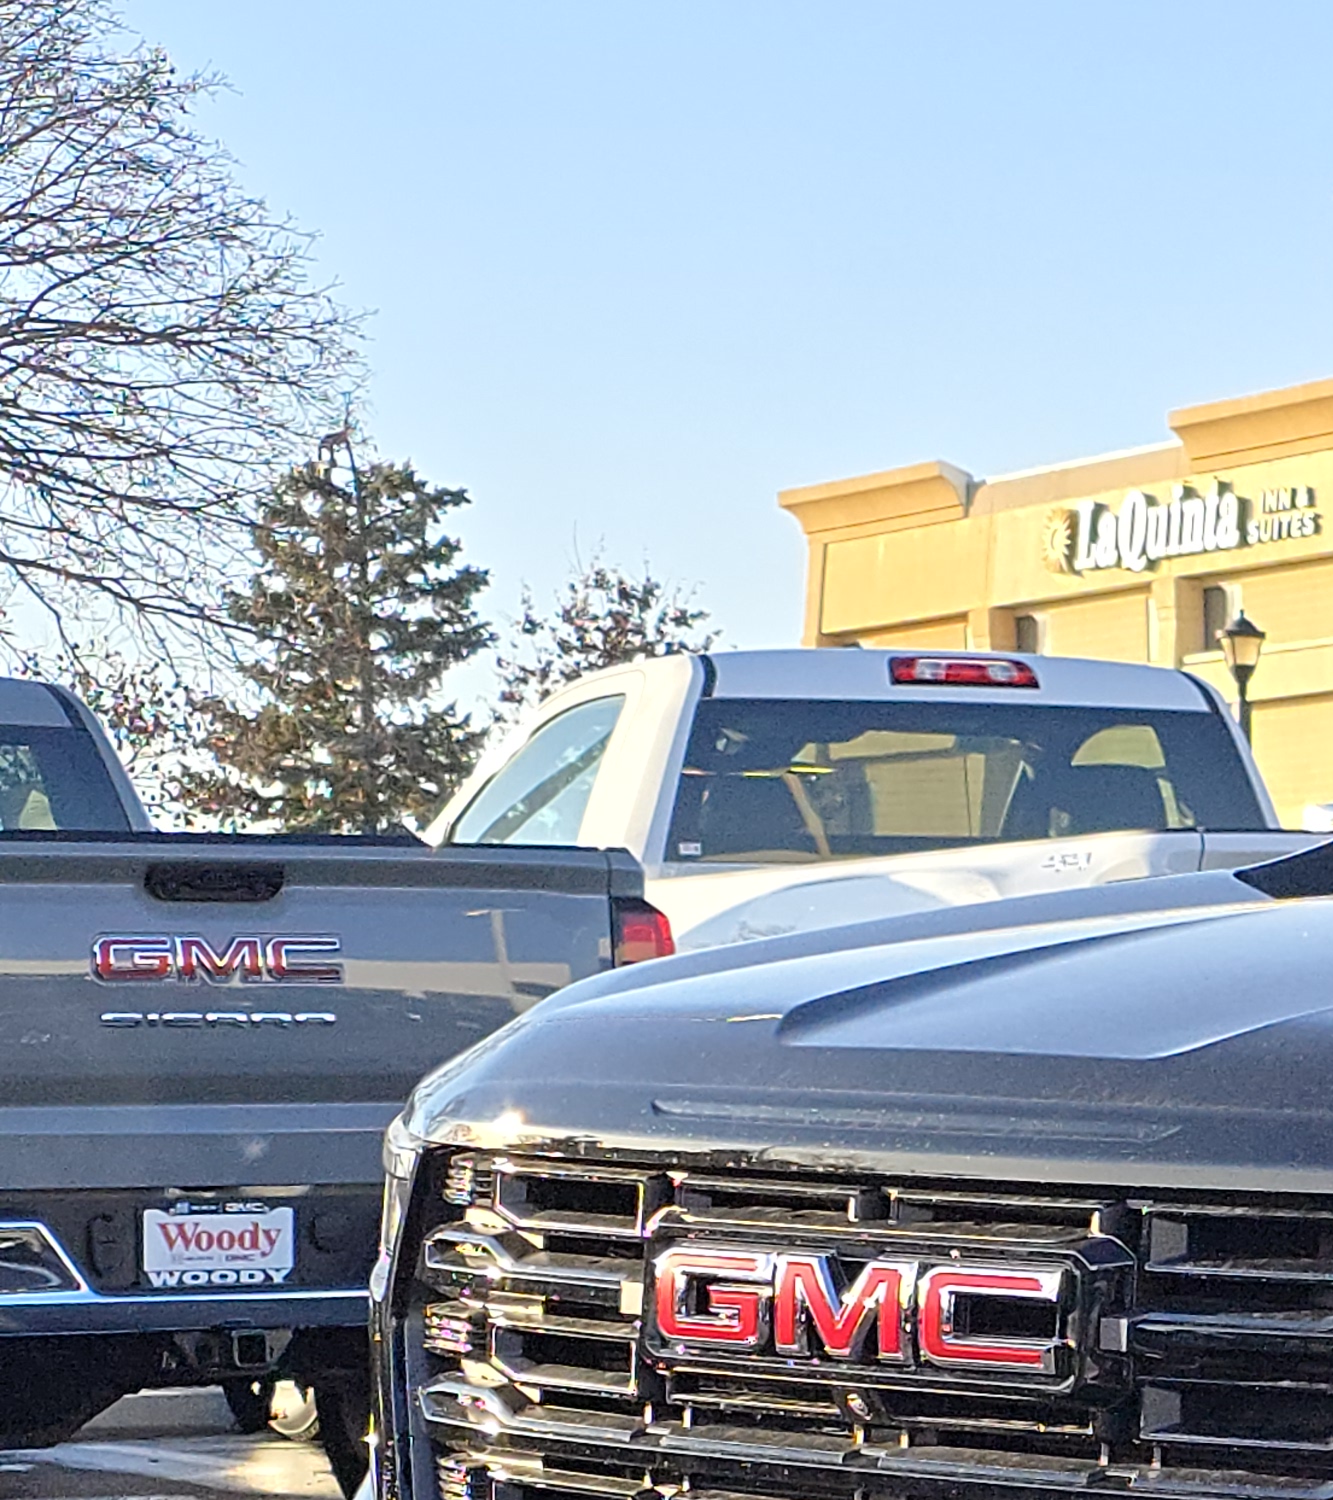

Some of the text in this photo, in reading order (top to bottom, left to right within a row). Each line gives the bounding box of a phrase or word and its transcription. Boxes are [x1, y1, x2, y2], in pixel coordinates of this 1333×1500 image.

[1261, 486, 1311, 513] INN &
[1247, 512, 1317, 545] SUITES
[94, 934, 344, 985] GMC
[99, 1011, 338, 1030] SIERRA
[157, 1222, 282, 1258] Woody
[147, 1268, 290, 1288] WOODY
[653, 1246, 1065, 1375] GMC
